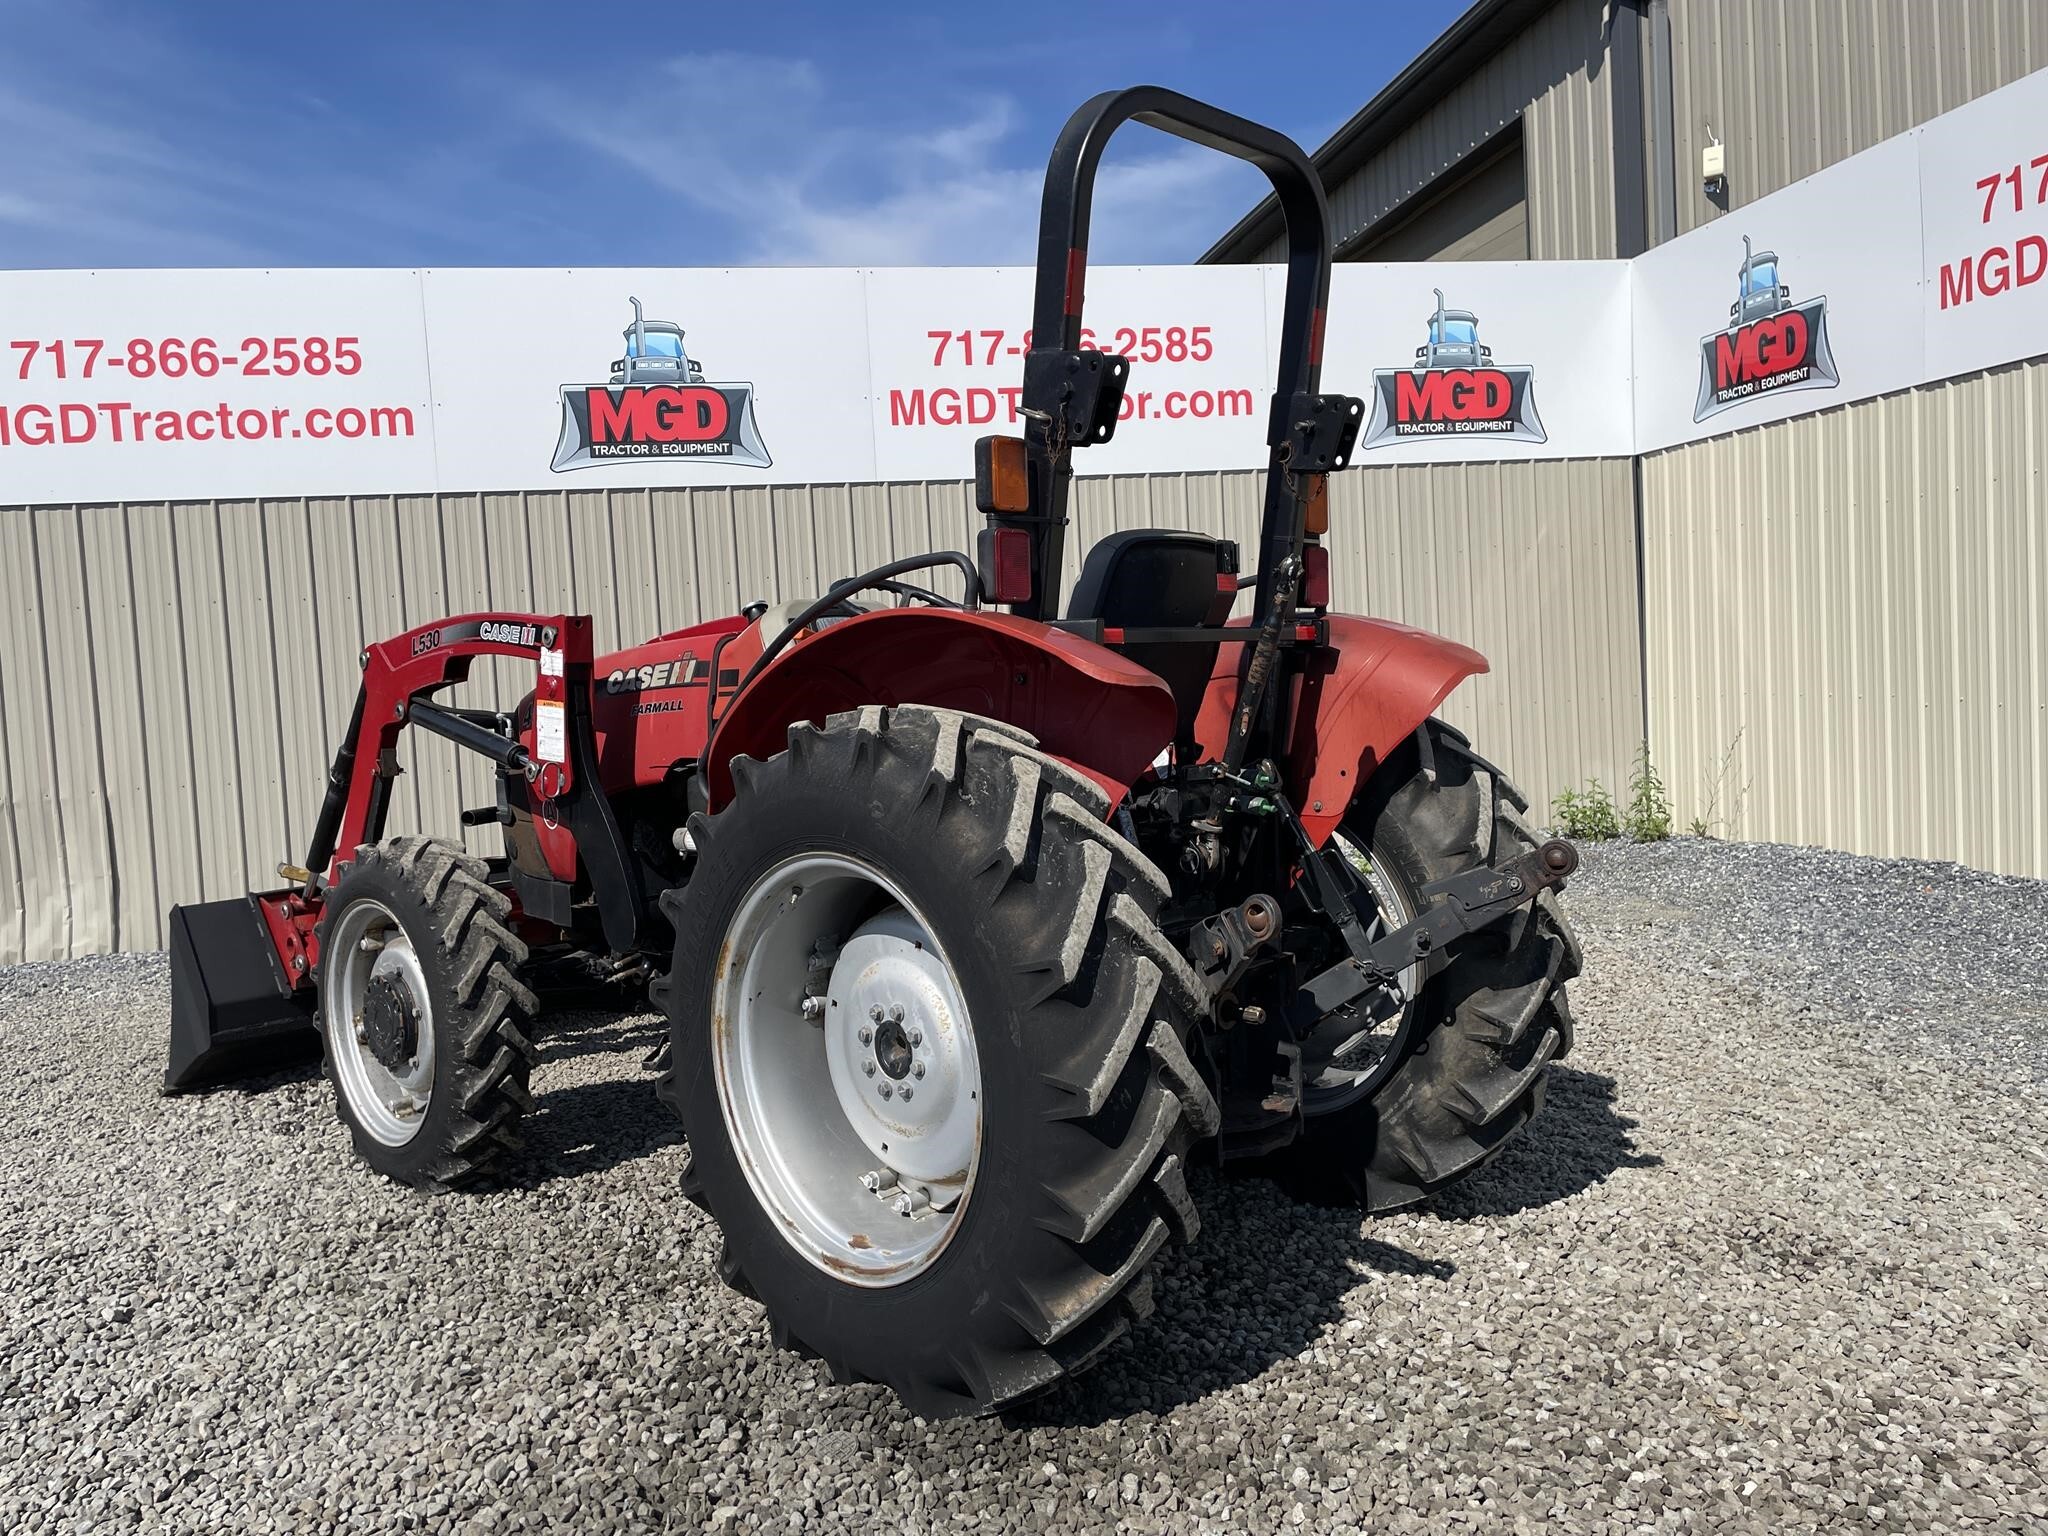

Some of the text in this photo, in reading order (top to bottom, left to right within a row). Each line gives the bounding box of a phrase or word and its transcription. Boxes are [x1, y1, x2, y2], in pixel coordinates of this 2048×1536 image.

[1940, 235, 2048, 310] MGD
[10, 337, 362, 380] 717-866-2585
[927, 326, 1214, 366] 717--2585
[1716, 310, 1808, 389] MGD
[1396, 369, 1512, 421] MGD
[1718, 367, 1808, 401] TRACTOR & EQUIPMENT
[587, 386, 729, 442] MGD
[1398, 420, 1512, 433] TRACTOR & EQUIPMENT
[593, 443, 730, 456] TRACTOR & EQUIPMENT
[411, 629, 440, 657] L530
[631, 700, 684, 717] FARMALL
